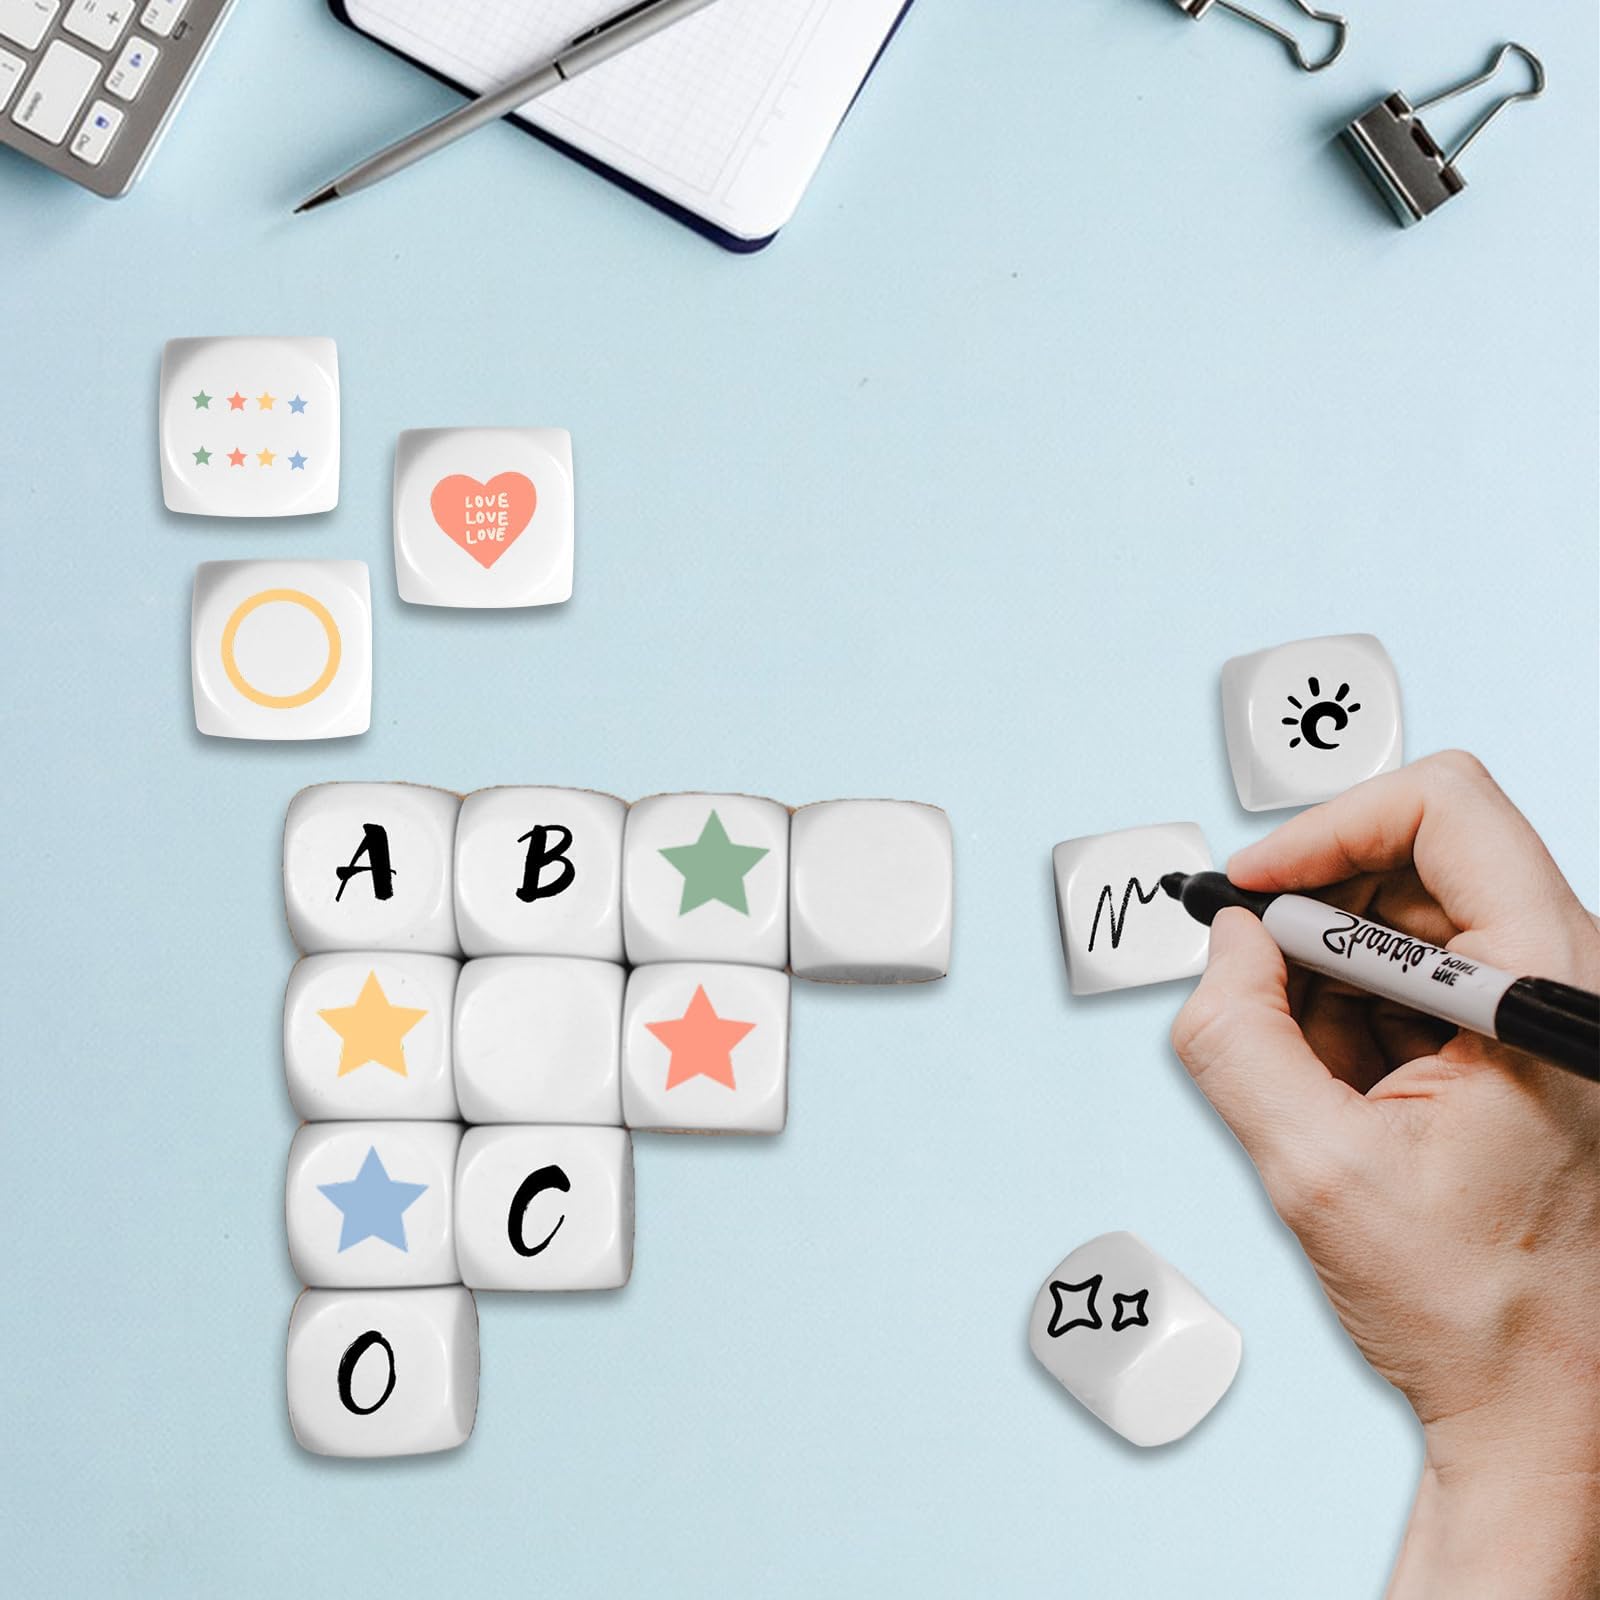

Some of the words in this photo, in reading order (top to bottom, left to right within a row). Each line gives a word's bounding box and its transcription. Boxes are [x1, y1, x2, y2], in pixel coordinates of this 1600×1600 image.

[464, 492, 510, 508] LOVE
[465, 511, 509, 526] LOVE
[465, 527, 507, 544] LOVE
[336, 824, 396, 902] A
[516, 825, 575, 902] B
[508, 1165, 570, 1257] C
[338, 1331, 396, 1415] O
